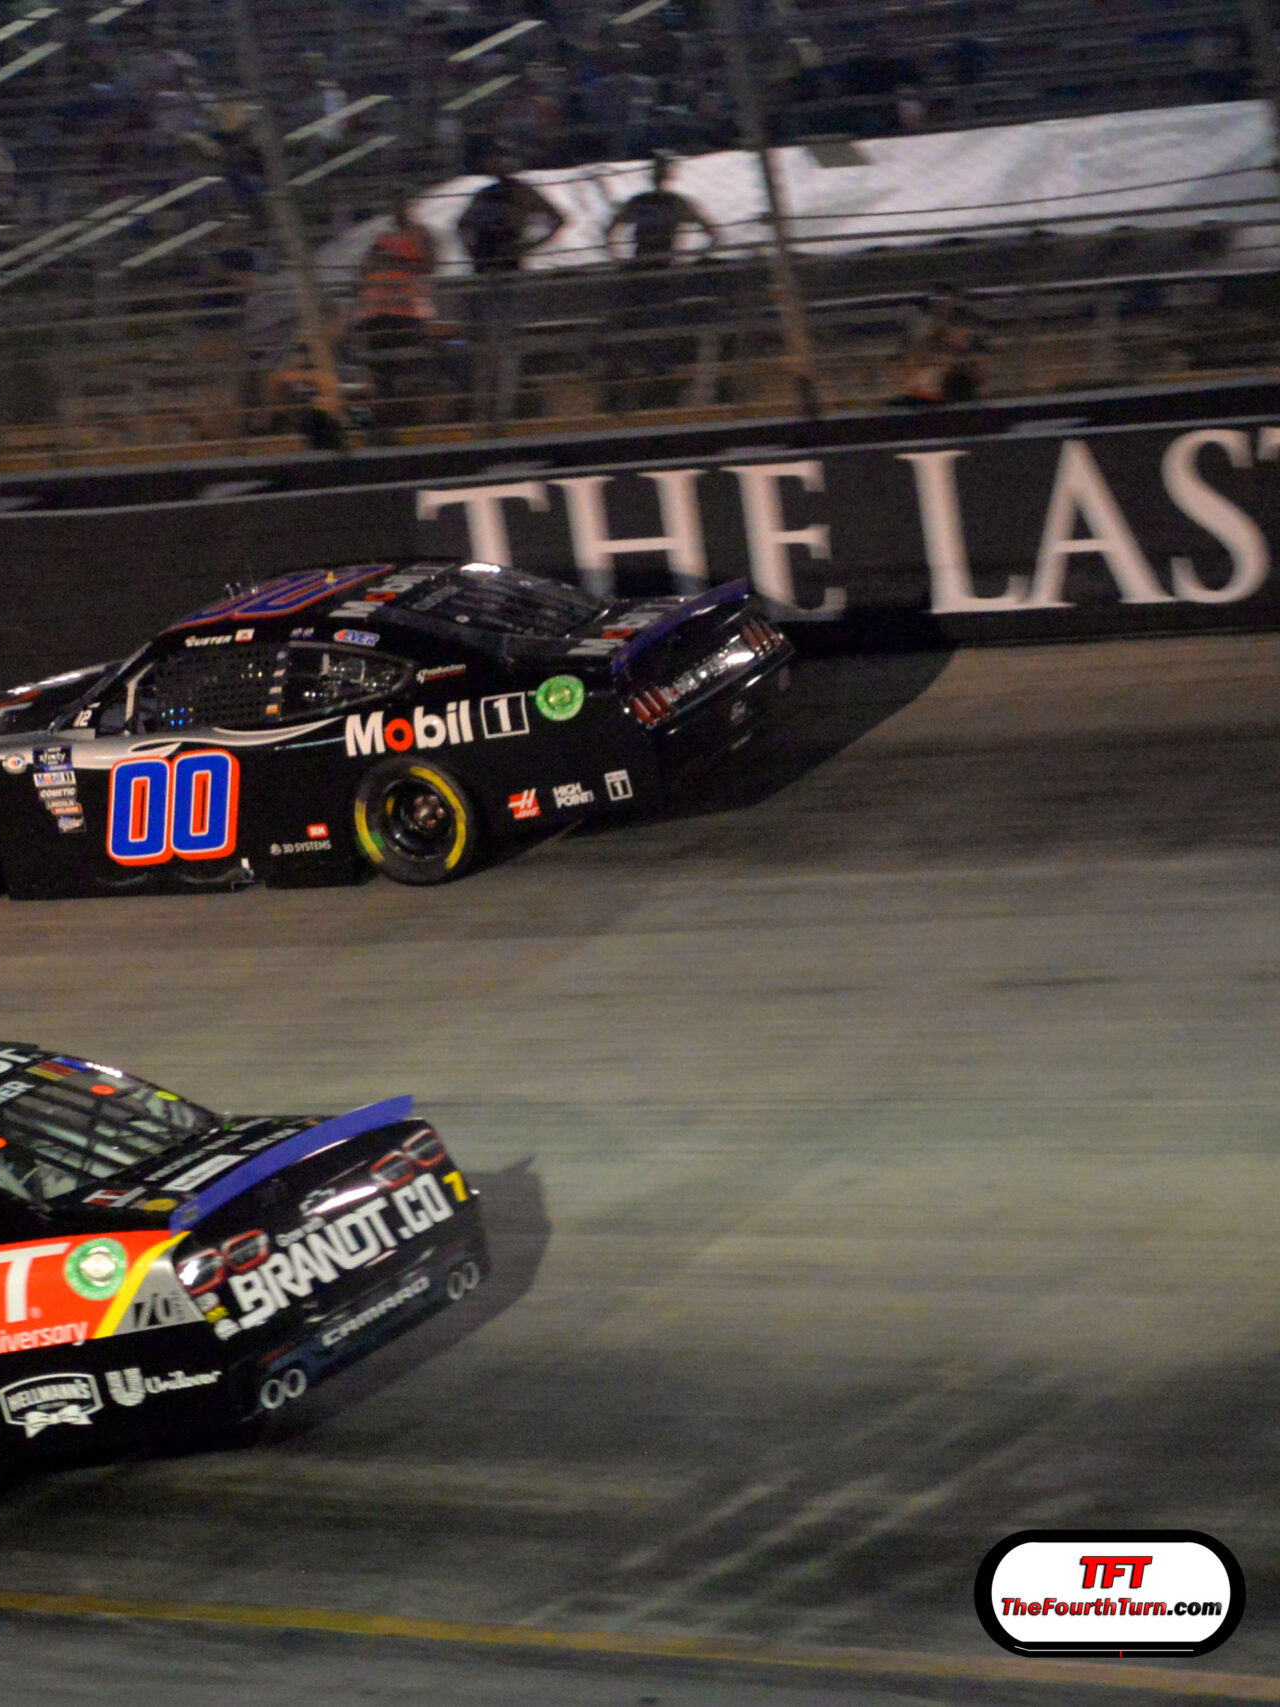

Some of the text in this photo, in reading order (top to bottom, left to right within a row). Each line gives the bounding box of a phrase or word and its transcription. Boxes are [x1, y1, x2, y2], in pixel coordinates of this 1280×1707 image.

[417, 428, 1280, 620] THE LAS
[345, 700, 474, 757] Mobil
[106, 749, 240, 866] 00
[228, 1173, 455, 1329] BRANDT.CO
